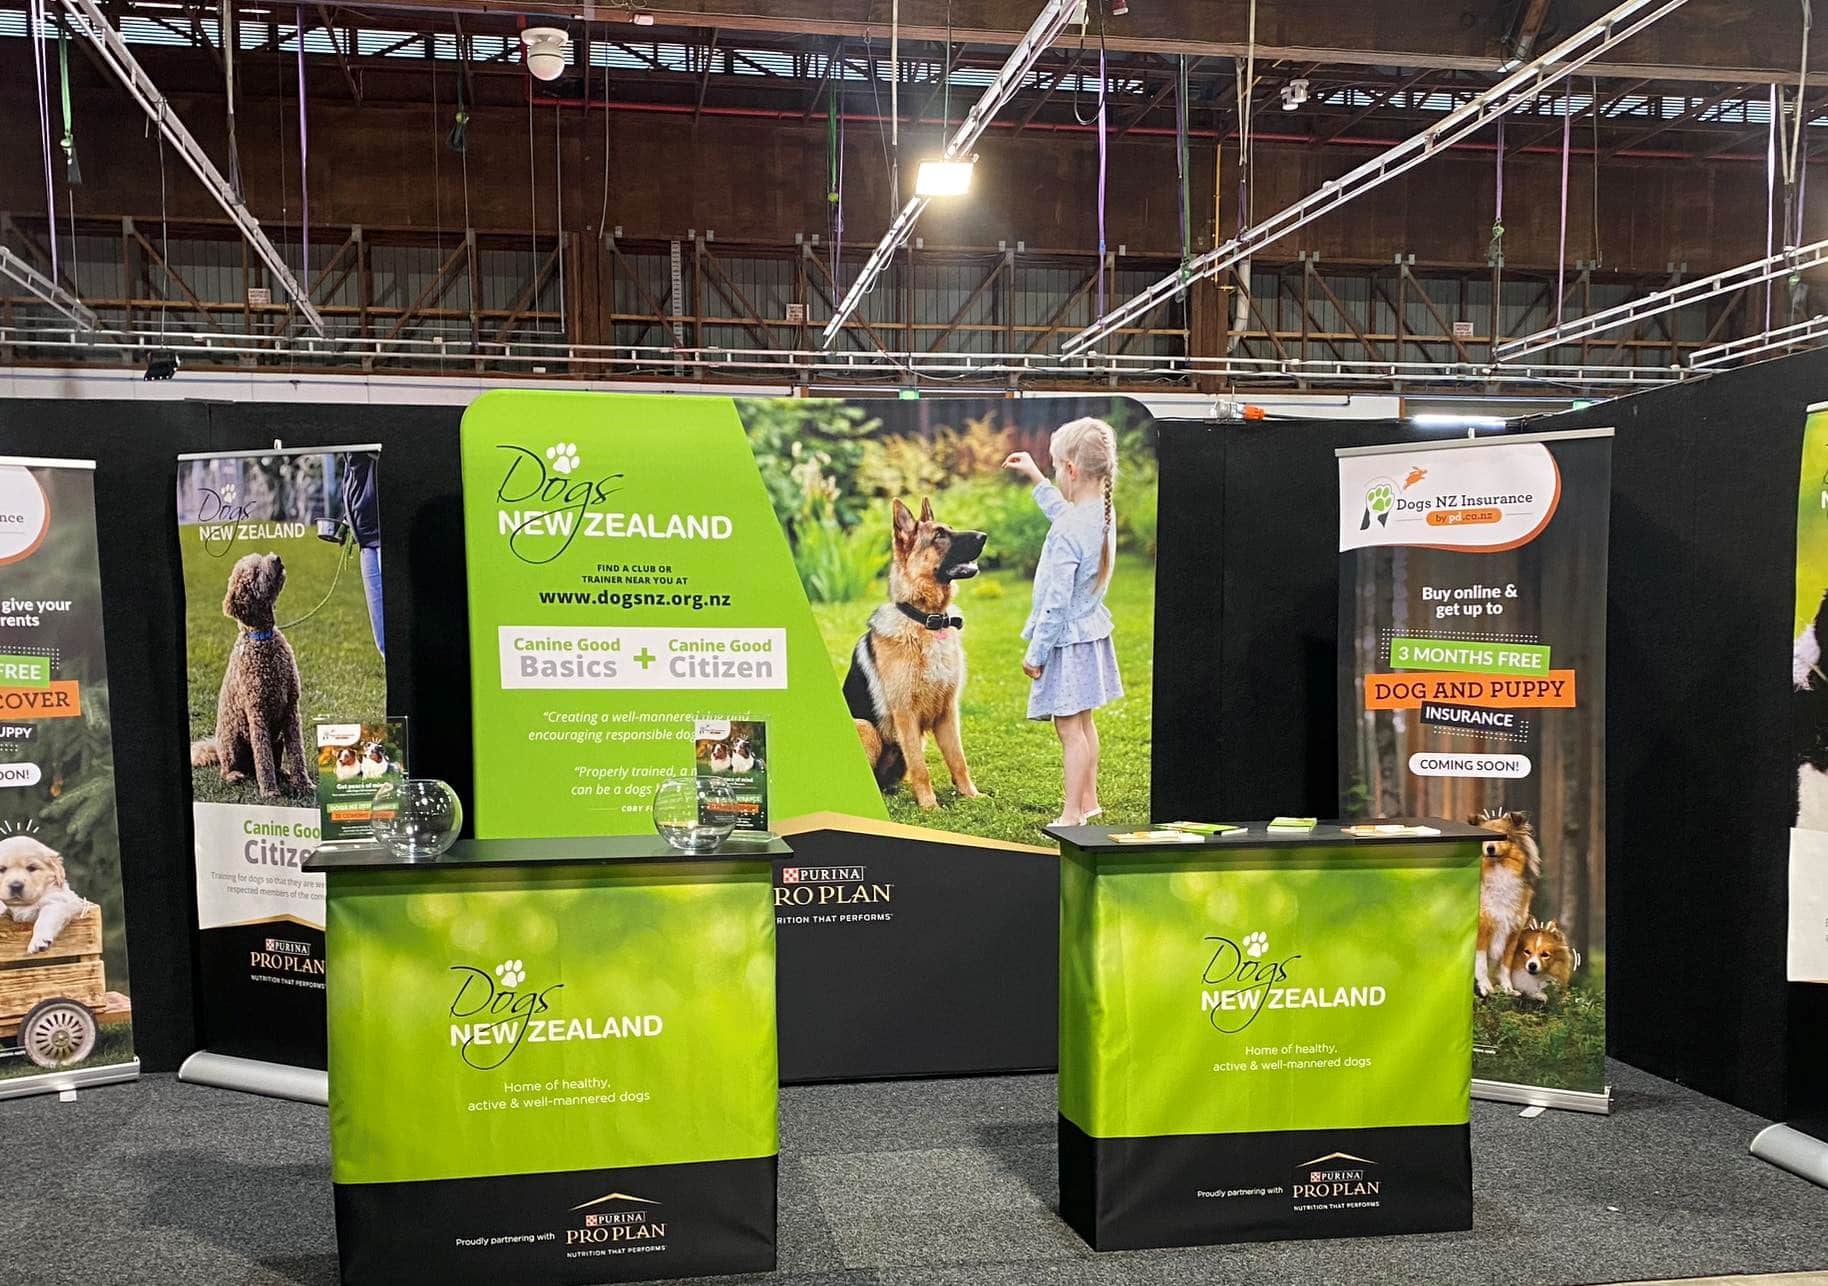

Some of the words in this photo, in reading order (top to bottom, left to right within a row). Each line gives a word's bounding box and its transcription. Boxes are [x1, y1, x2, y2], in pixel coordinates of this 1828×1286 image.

[496, 445, 624, 564] Dogs
[1397, 498, 1432, 513] Dogs
[1436, 496, 1457, 508] NZ
[1461, 493, 1533, 507] Insurance
[198, 487, 256, 558] Dogs
[498, 510, 573, 536] NEW
[584, 513, 733, 540] ZEALAND
[1435, 513, 1447, 523] by
[1448, 511, 1493, 524] pd.co.nz
[199, 525, 233, 541] NEW
[238, 523, 305, 539] ZEALAND
[597, 564, 620, 573] FIND
[622, 564, 629, 573] A
[631, 564, 656, 573] CLUB
[658, 565, 672, 573] OR
[582, 575, 623, 584] TRAINER
[625, 576, 652, 584] NEAR
[654, 577, 673, 585] YOU
[675, 577, 688, 585] AT
[539, 590, 731, 609] www.dogsnz.org.nz
[1422, 586, 1451, 602] Buy
[1454, 584, 1501, 599] online
[1505, 584, 1518, 598] &
[2, 597, 34, 614] give
[36, 600, 72, 614] your
[1436, 603, 1460, 618] get
[1464, 604, 1483, 617] up
[1487, 602, 1503, 615] to
[0, 614, 40, 627] rents
[514, 638, 574, 651] Canine
[577, 638, 621, 652] Good
[668, 639, 726, 652] Canine
[729, 639, 772, 653] Good
[1398, 646, 1409, 660] 3
[1413, 648, 1493, 666] MONTHS
[1498, 651, 1542, 668] FREE
[520, 655, 617, 678] Basics
[669, 656, 772, 678] Citizen
[1375, 682, 1426, 700] DOG
[1433, 682, 1483, 698] AND
[1490, 680, 1565, 698] PUPPY
[601, 714, 609, 723] a
[612, 711, 699, 723] well-mannered
[1425, 706, 1514, 727] INSURANCE
[0, 726, 32, 739] UPPY
[528, 730, 603, 744] encouraging
[606, 729, 672, 743] responsible
[632, 766, 676, 778] trained,
[1420, 759, 1473, 771] COMING
[1477, 760, 1519, 771] SOON!
[571, 787, 592, 795] can
[596, 784, 610, 795] be
[613, 786, 621, 795] a
[625, 784, 652, 798] dogs
[243, 820, 290, 837] Canine
[293, 823, 320, 839] Goo
[244, 839, 310, 868] Citize
[211, 872, 237, 884] Training
[238, 873, 248, 882] for
[249, 875, 264, 886] dogs
[275, 876, 287, 885] that
[288, 878, 301, 889] they
[303, 880, 313, 888] are
[800, 868, 861, 881] PURINA
[227, 886, 259, 896] respected
[260, 888, 289, 898] members
[290, 889, 298, 898] of
[298, 891, 309, 900] the
[773, 886, 813, 905] RO
[818, 884, 891, 904] PLAN
[776, 916, 810, 924] RITION
[813, 915, 837, 923] THAT
[840, 914, 891, 922] PERFORMS
[275, 941, 308, 954] PURINA
[250, 951, 282, 969] PRO
[284, 956, 325, 974] PLAN
[250, 974, 280, 983] NUTRITION
[281, 977, 294, 985] THAT
[295, 980, 325, 989] PERFORMS
[1202, 937, 1301, 1033] Dogs
[1201, 990, 1260, 1011] NEW
[1268, 986, 1386, 1009] ZEALAND
[449, 966, 564, 1070] Dogs
[450, 1022, 518, 1047] NEW
[527, 1015, 663, 1043] ZEALAND
[1245, 1047, 1278, 1056] Home
[1281, 1044, 1292, 1055] of
[1213, 1062, 1247, 1072] active
[1250, 1061, 1258, 1070] &
[1261, 1058, 1340, 1071] well-mannered
[1343, 1057, 1371, 1068] dogs
[504, 1082, 541, 1093] Home
[545, 1080, 558, 1090] of
[468, 1099, 506, 1112] active
[510, 1099, 520, 1108] &
[523, 1093, 616, 1108] well-mannered
[619, 1091, 650, 1104] dogs
[1321, 1172, 1360, 1181] PURINA
[1197, 1189, 1226, 1199] Proudly
[1227, 1187, 1266, 1198] partnering
[1267, 1186, 1283, 1195] with
[1293, 1184, 1330, 1198] PRO
[1333, 1182, 1380, 1197] PLAN
[598, 1214, 642, 1224] PURINA
[456, 1237, 489, 1248] Proudly
[490, 1234, 535, 1246] partnering
[536, 1232, 555, 1241] with
[566, 1228, 608, 1245] PRO
[612, 1224, 665, 1241] PLAN
[567, 1250, 606, 1258] NUTRITION
[627, 1246, 666, 1254] PERFORMS
